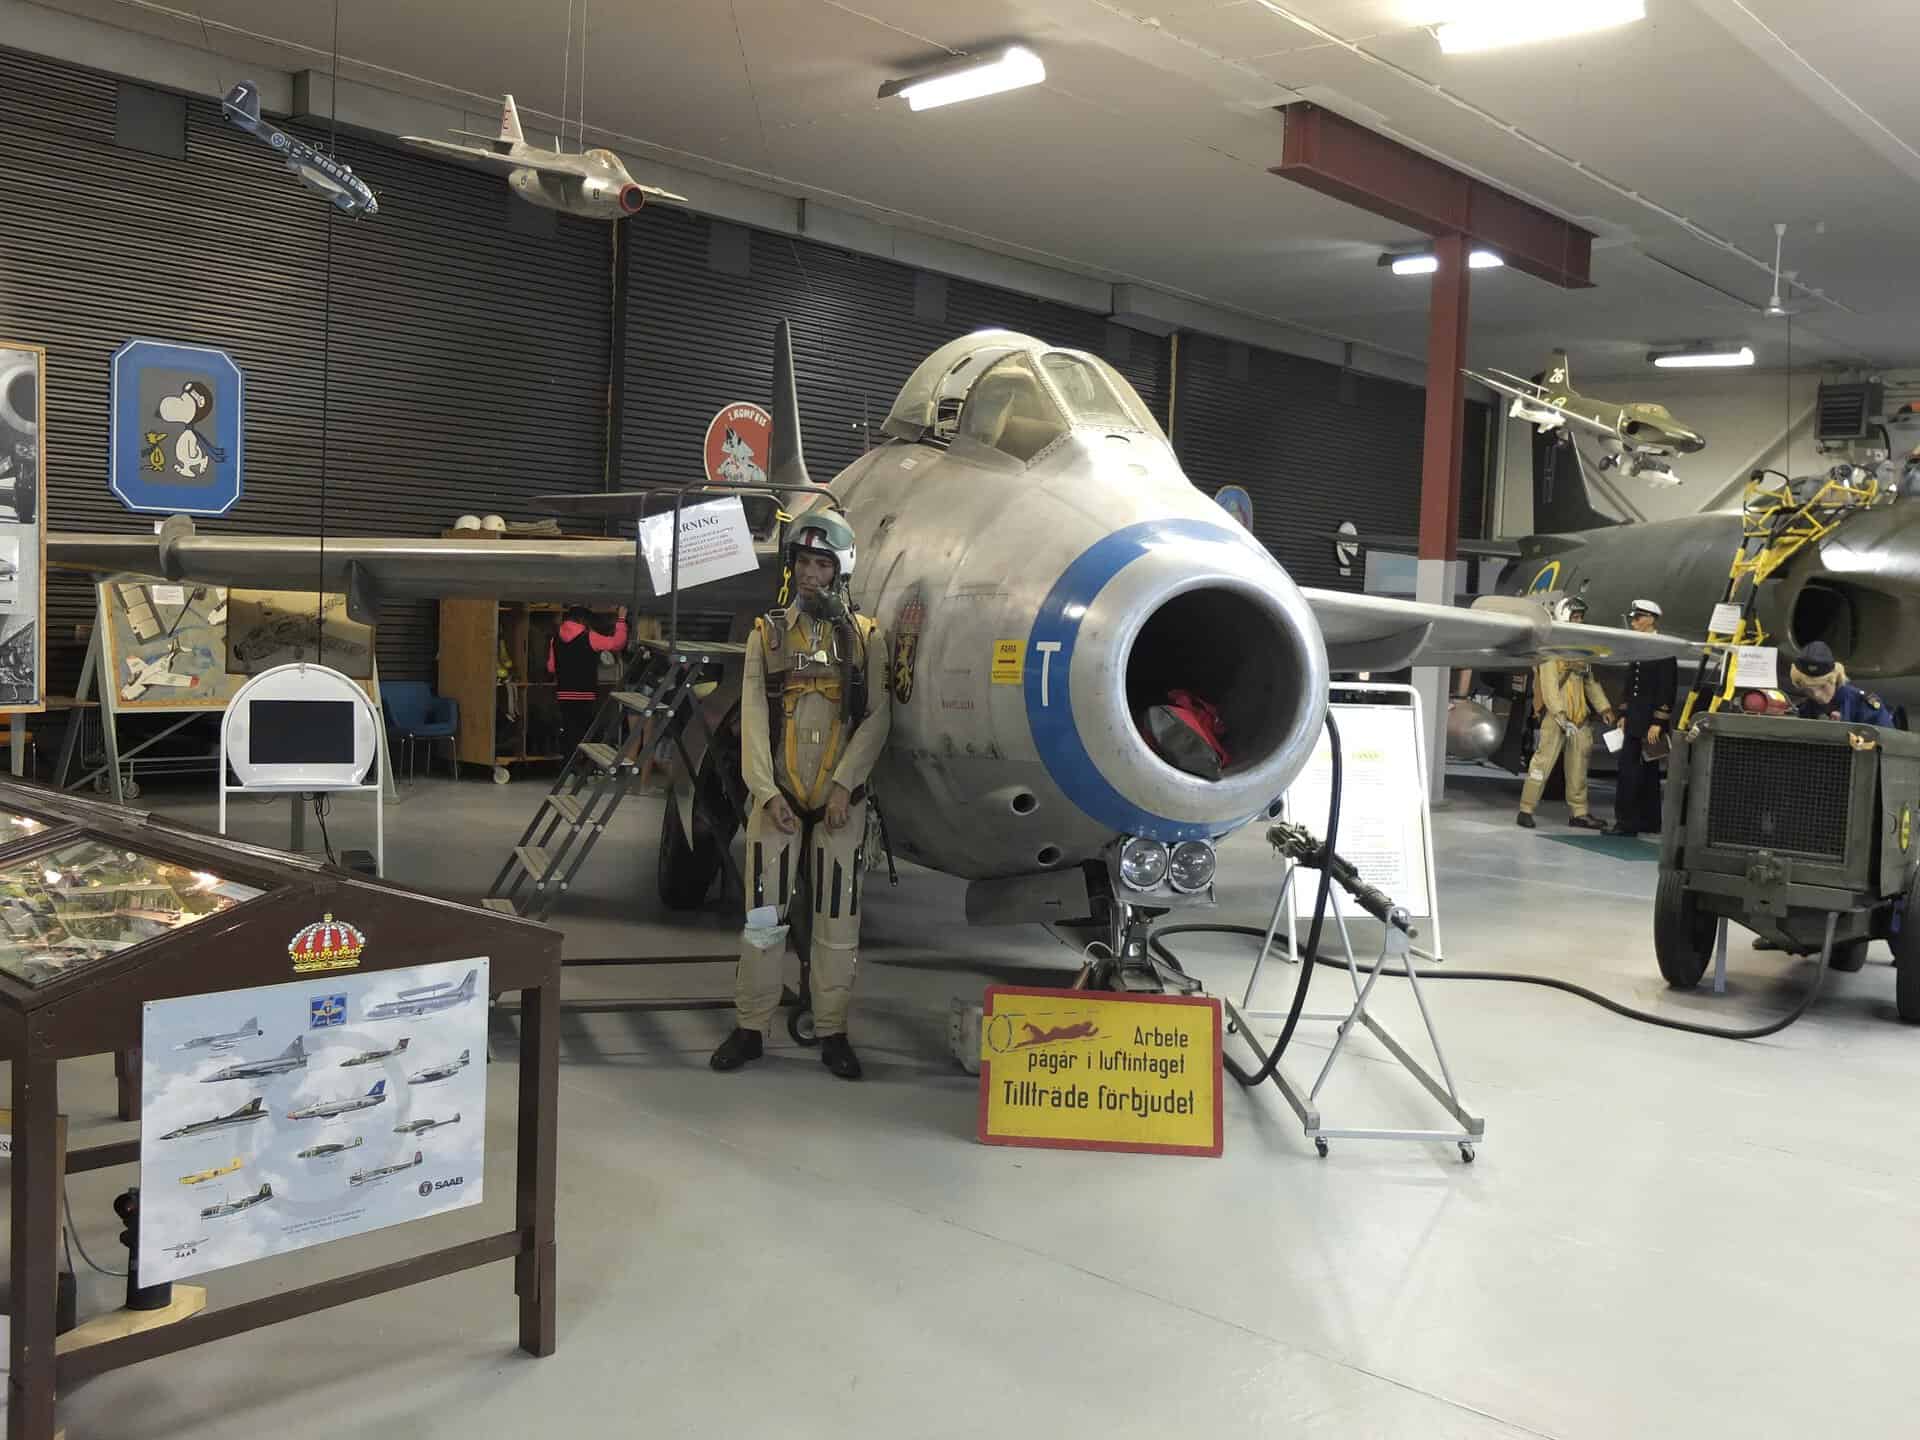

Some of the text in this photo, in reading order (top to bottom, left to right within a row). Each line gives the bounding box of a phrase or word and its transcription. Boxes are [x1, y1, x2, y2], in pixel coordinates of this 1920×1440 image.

[236, 86, 249, 103] 7
[1549, 367, 1566, 384] 26
[1036, 641, 1062, 707] T
[1133, 1025, 1189, 1048] Arbete
[1087, 1050, 1092, 1070] i
[1098, 1050, 1186, 1079] luftintaget
[1003, 1080, 1195, 1118] Tillträde förbjudet
[434, 1176, 464, 1190] SAAB
